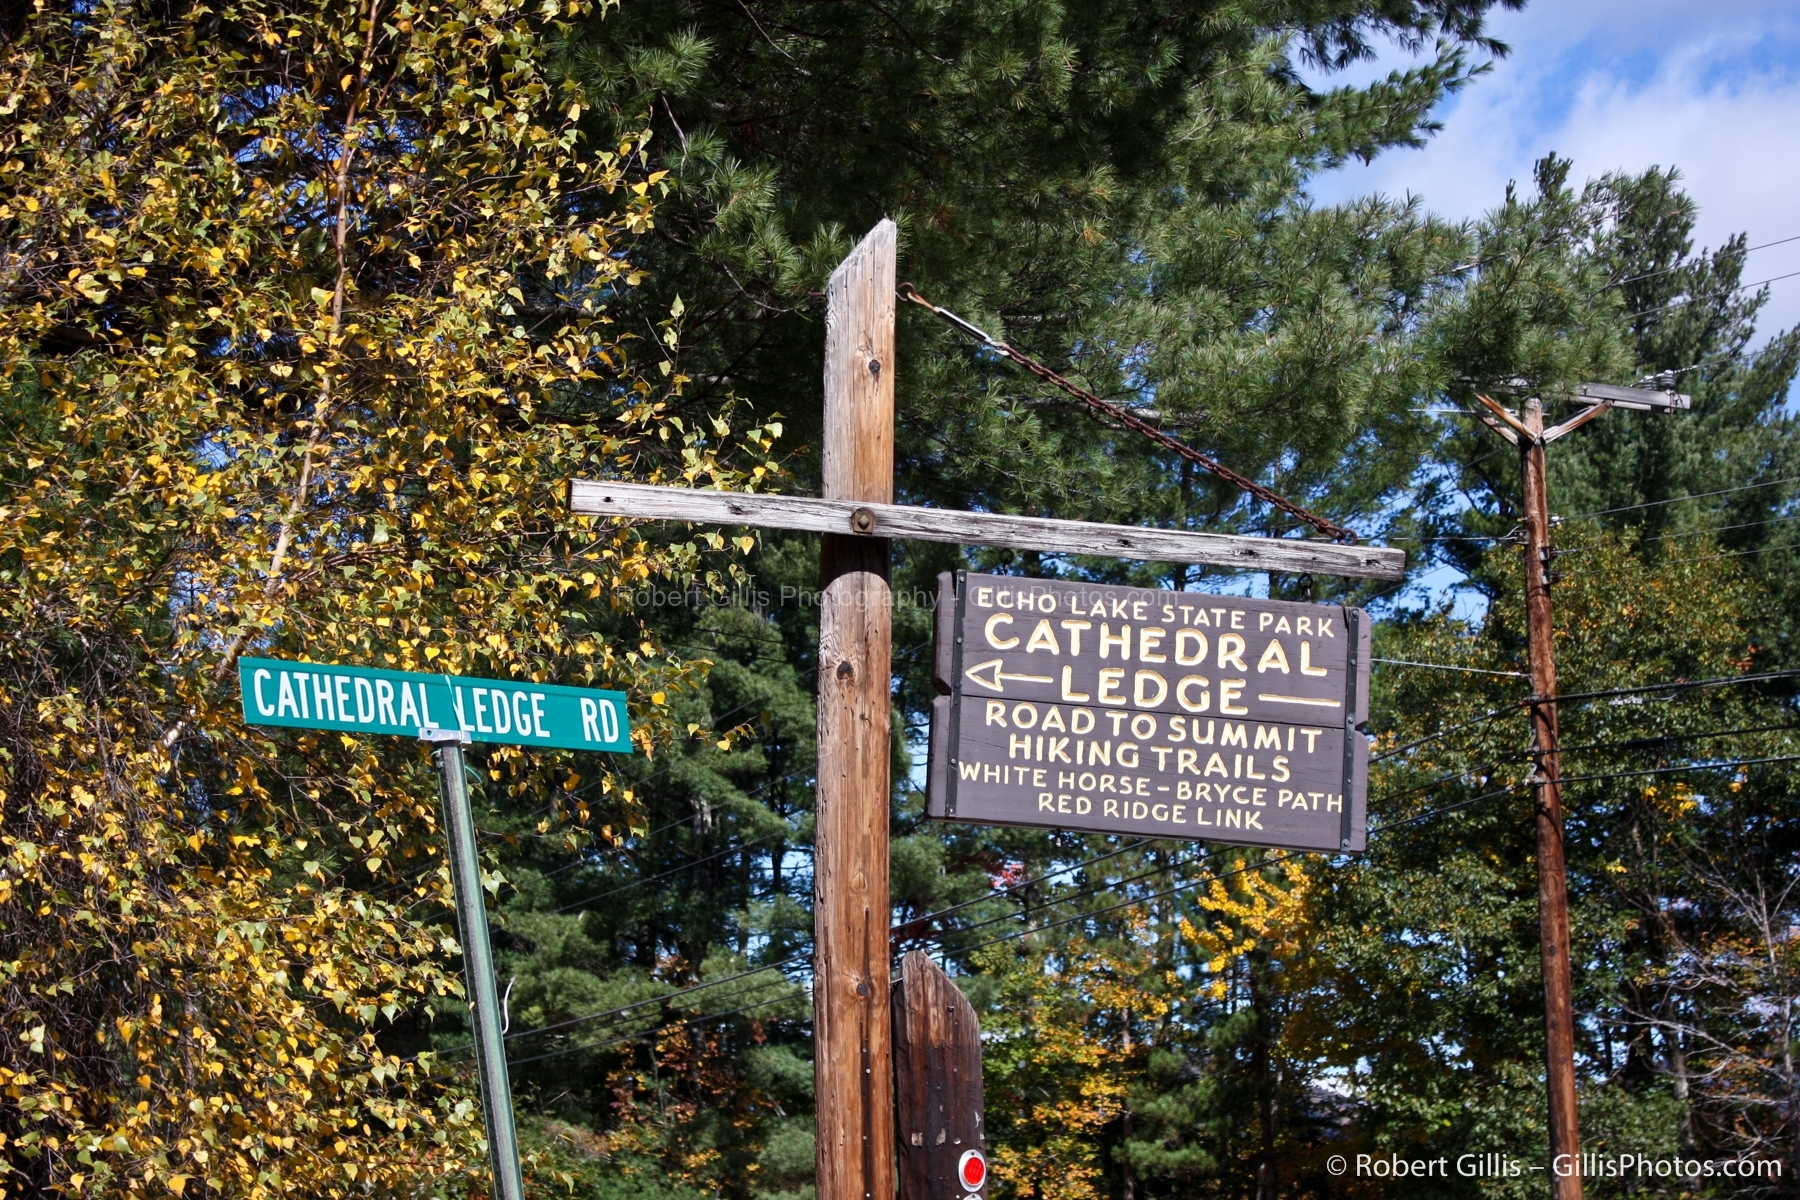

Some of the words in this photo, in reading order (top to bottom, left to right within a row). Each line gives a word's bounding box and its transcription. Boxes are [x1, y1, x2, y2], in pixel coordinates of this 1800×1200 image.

[978, 587, 1056, 613] ECHO
[1072, 595, 1148, 621] LAKE
[1161, 604, 1246, 630] STATE
[1259, 612, 1335, 638] PARK
[984, 613, 1328, 677] CATHEDRAL
[253, 668, 439, 729] CATHEDRAL
[454, 685, 551, 738] LEDGE
[580, 697, 620, 743] RD
[1061, 664, 1248, 715] LEDGE
[986, 700, 1095, 735] ROAD
[1106, 711, 1157, 740] TO
[1168, 715, 1323, 754] SUMMIT
[1009, 733, 1139, 769] HIKING
[1150, 745, 1291, 783] TRAILS
[958, 761, 1047, 788] WHITE
[1058, 771, 1151, 796] HORSE
[1177, 780, 1267, 806] BRYCE
[1278, 789, 1343, 814] PATH
[1038, 792, 1092, 815] RED
[1104, 799, 1187, 824] RIDGE
[1198, 806, 1264, 831] LINK
